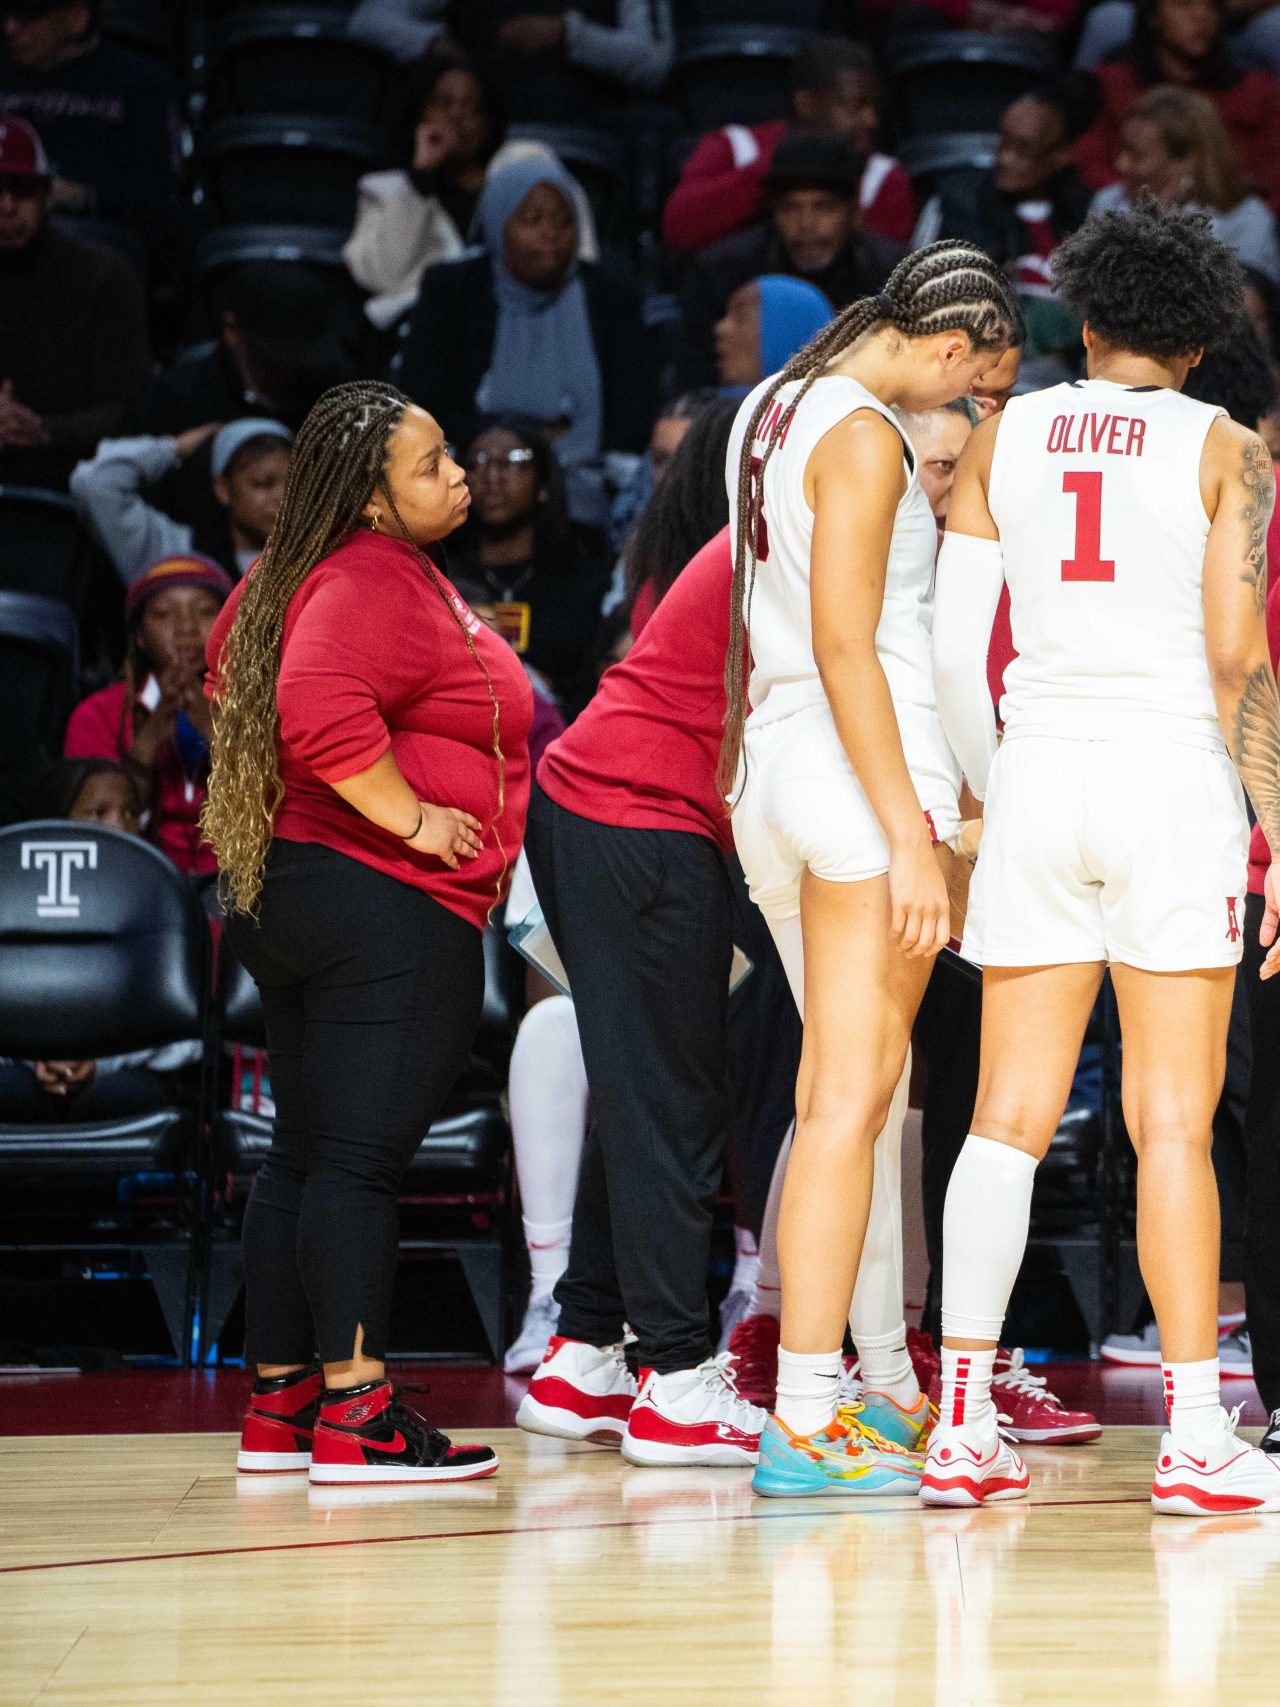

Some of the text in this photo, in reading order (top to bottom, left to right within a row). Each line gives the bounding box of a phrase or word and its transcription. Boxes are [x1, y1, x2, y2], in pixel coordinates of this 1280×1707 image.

[1047, 413, 1147, 456] OLIVER
[1061, 472, 1115, 582] 1
[22, 842, 97, 917] T
